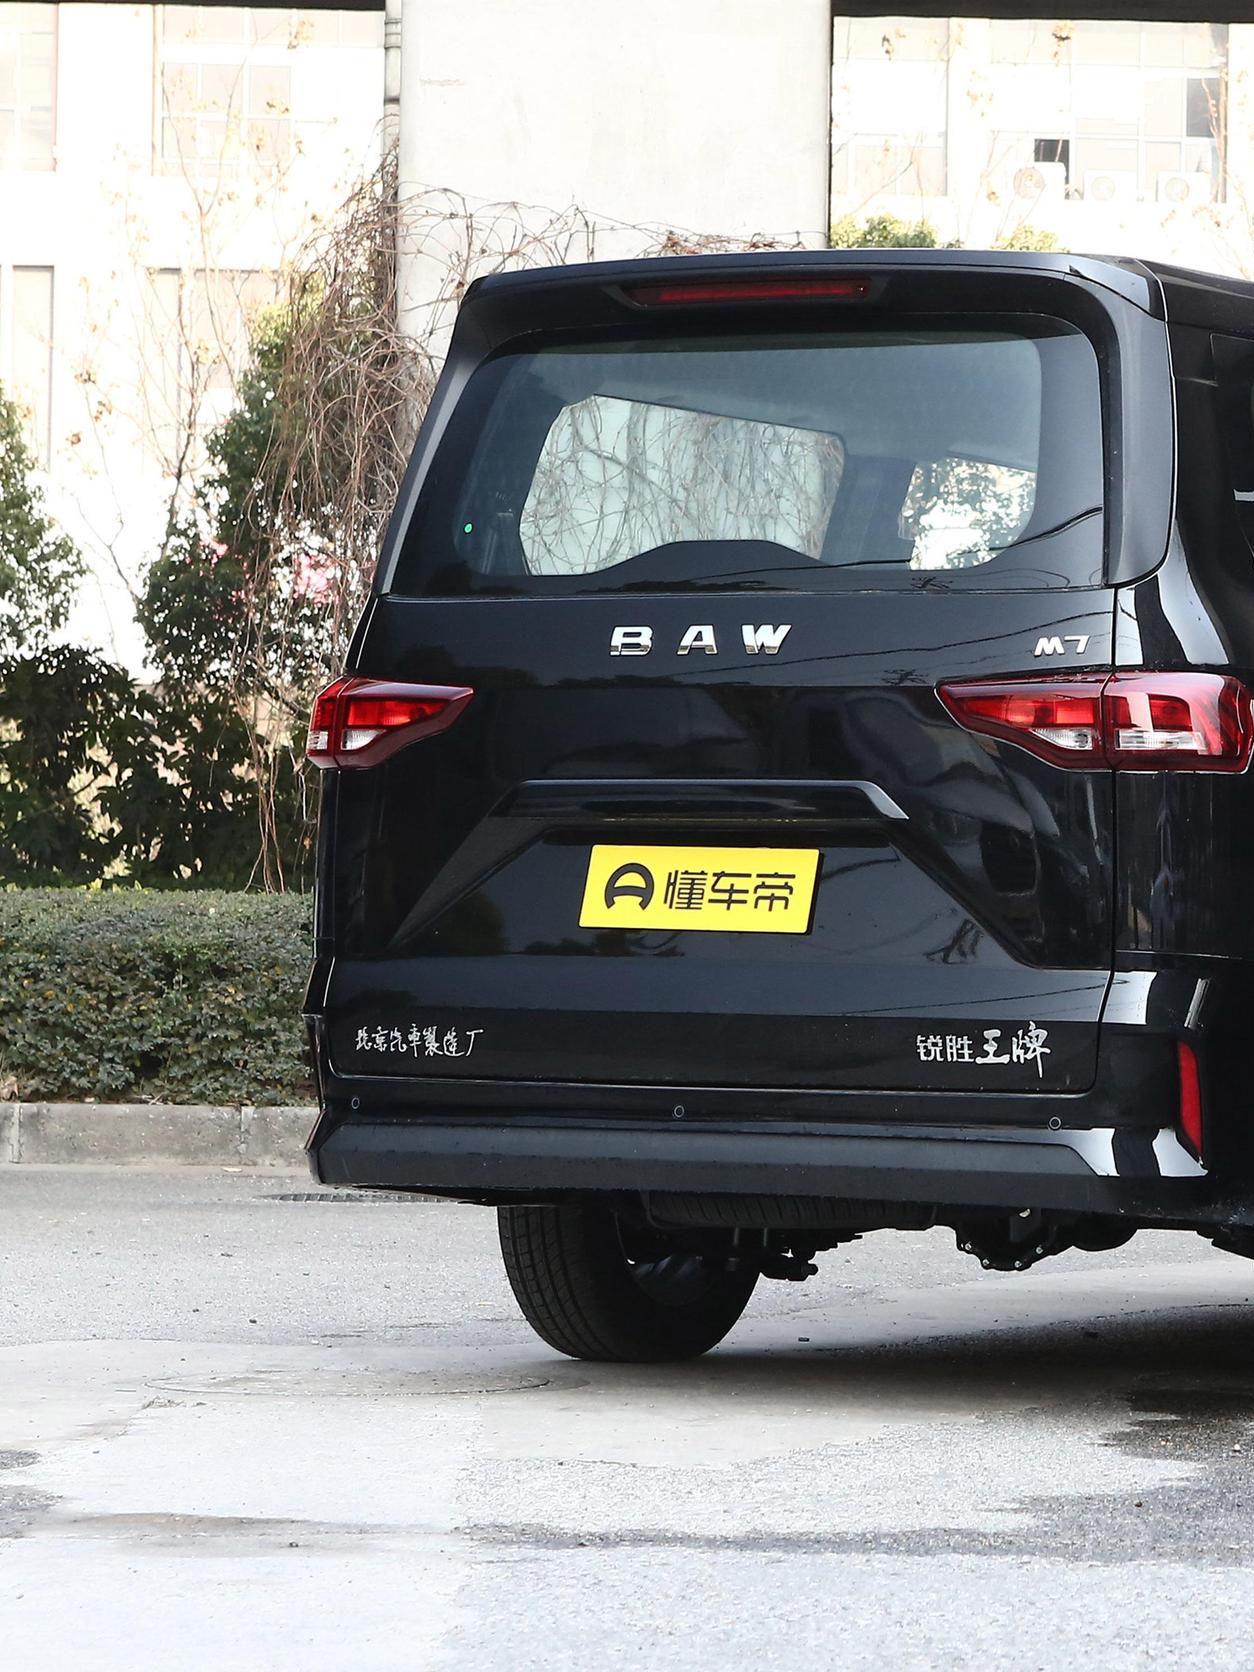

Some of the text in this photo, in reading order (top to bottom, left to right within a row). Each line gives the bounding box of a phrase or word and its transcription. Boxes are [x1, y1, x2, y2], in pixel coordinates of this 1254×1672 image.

[610, 624, 792, 655] BAW
[1034, 635, 1090, 656] M7
[664, 870, 797, 911] 懂车帝
[917, 1021, 1051, 1078] 锐胜王牌
